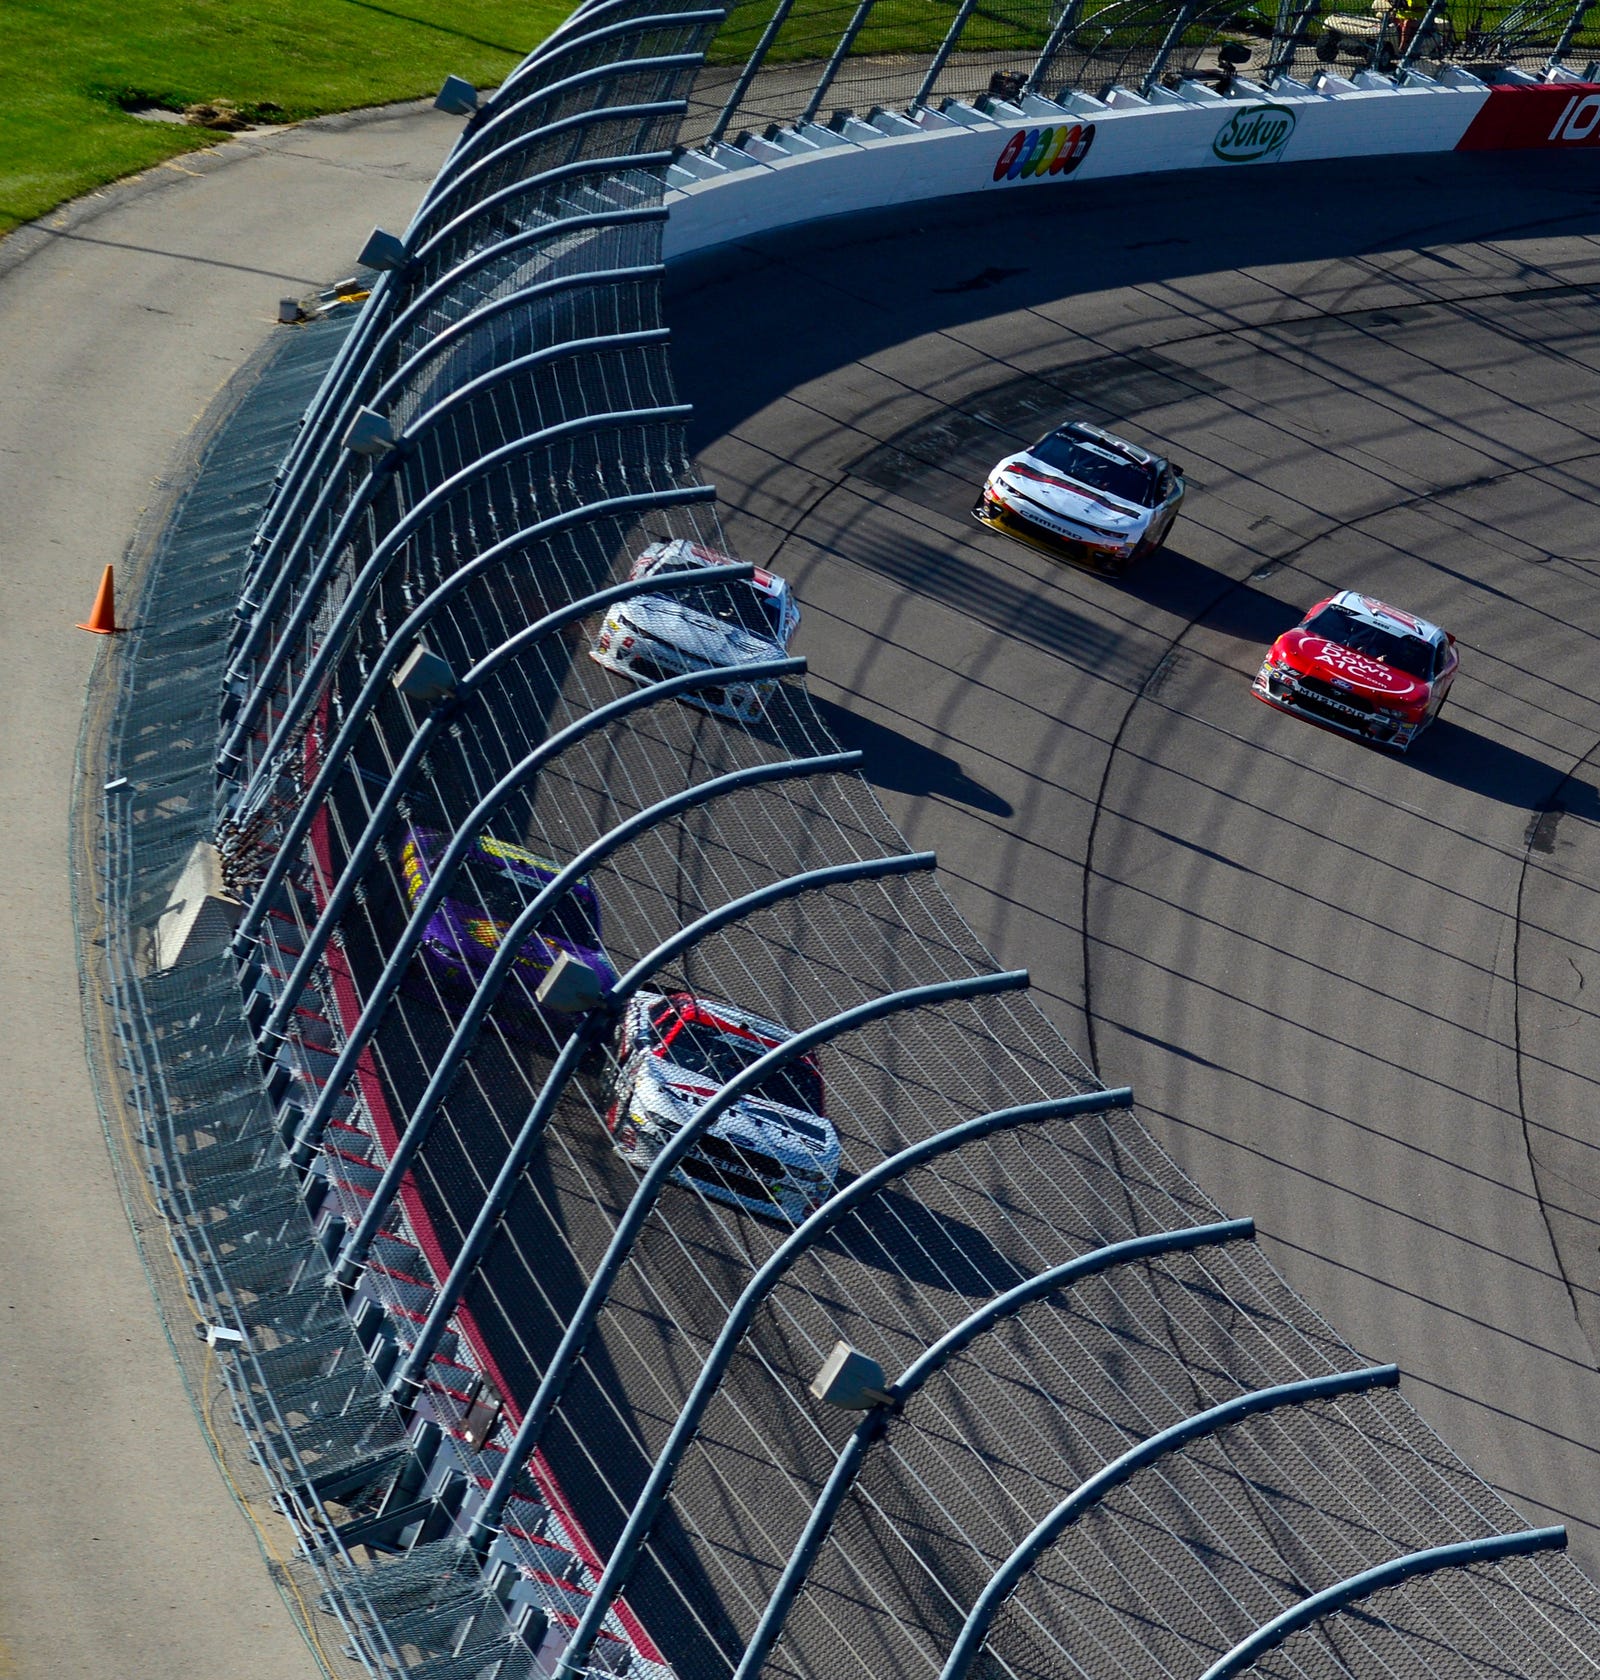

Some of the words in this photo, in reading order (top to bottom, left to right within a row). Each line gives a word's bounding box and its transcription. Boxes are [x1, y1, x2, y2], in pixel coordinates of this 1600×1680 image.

[1221, 106, 1288, 155] Sukup
[1020, 509, 1083, 541] CAMARO
[1320, 647, 1393, 681] Down
[1326, 642, 1390, 671] Drive
